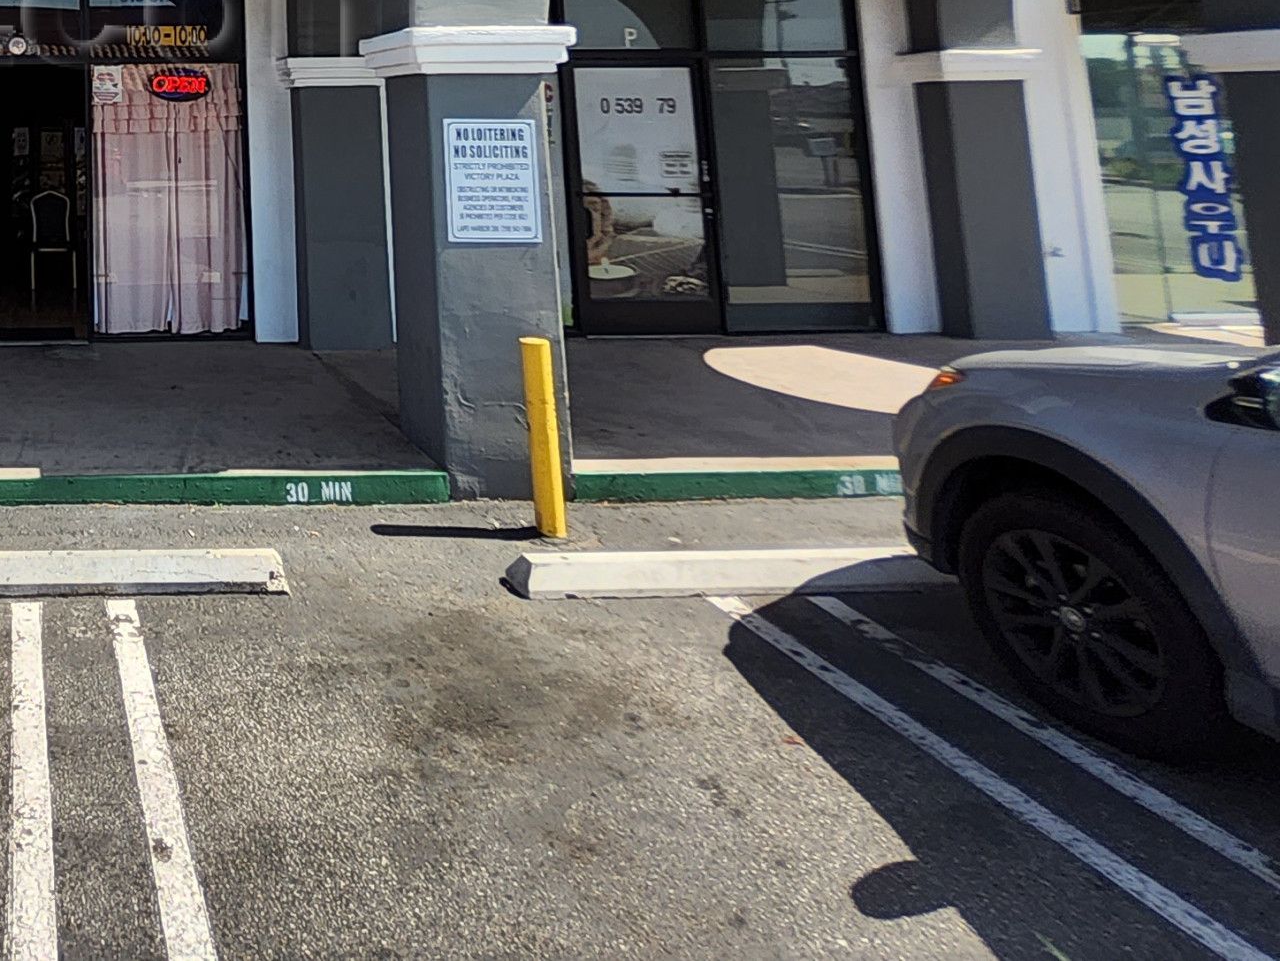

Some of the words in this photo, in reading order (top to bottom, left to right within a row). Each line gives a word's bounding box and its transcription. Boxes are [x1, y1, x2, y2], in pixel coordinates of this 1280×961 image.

[624, 27, 637, 48] P
[152, 76, 207, 94] OPEN
[455, 128, 469, 141] NO
[471, 128, 525, 141] LOITERING
[453, 145, 467, 158] NO
[469, 145, 529, 158] SOLICITING
[285, 481, 309, 503] 30
[320, 481, 353, 503] MIN
